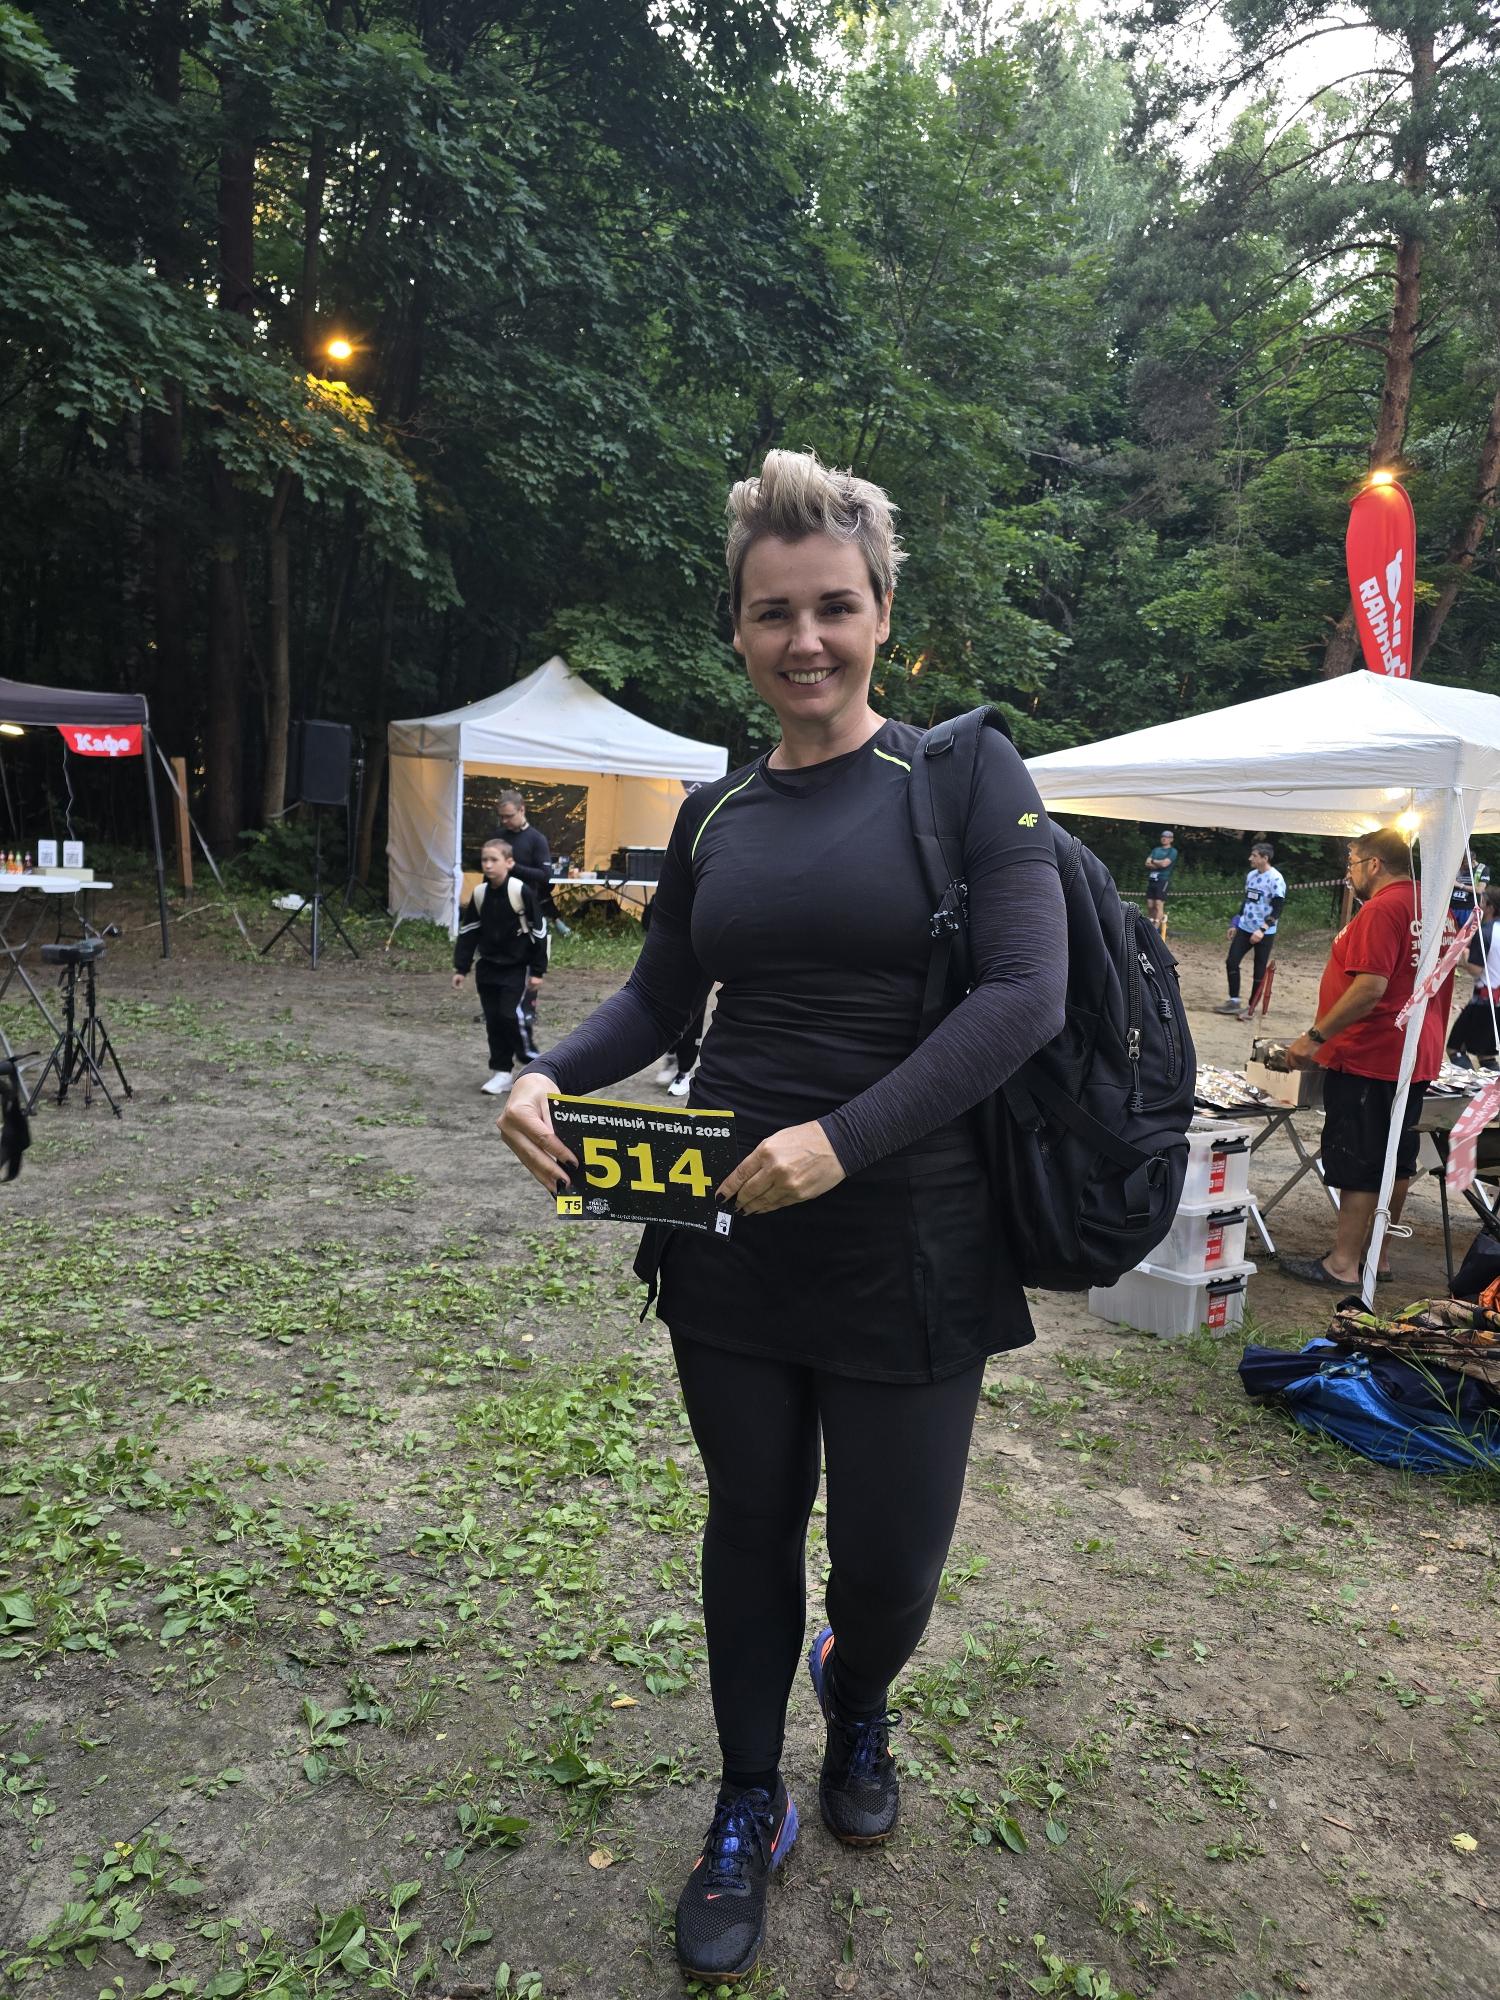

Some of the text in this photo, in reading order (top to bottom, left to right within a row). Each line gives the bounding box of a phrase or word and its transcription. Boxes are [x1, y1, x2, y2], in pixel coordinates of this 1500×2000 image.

[74, 733, 130, 757] Кафе
[1018, 813, 1039, 828] 4F
[554, 1111, 731, 1138] СУМЕРЕЧНЫЙ ТРЕЙЛ 2026
[582, 1137, 712, 1197] 514
[565, 1201, 581, 1211] T5
